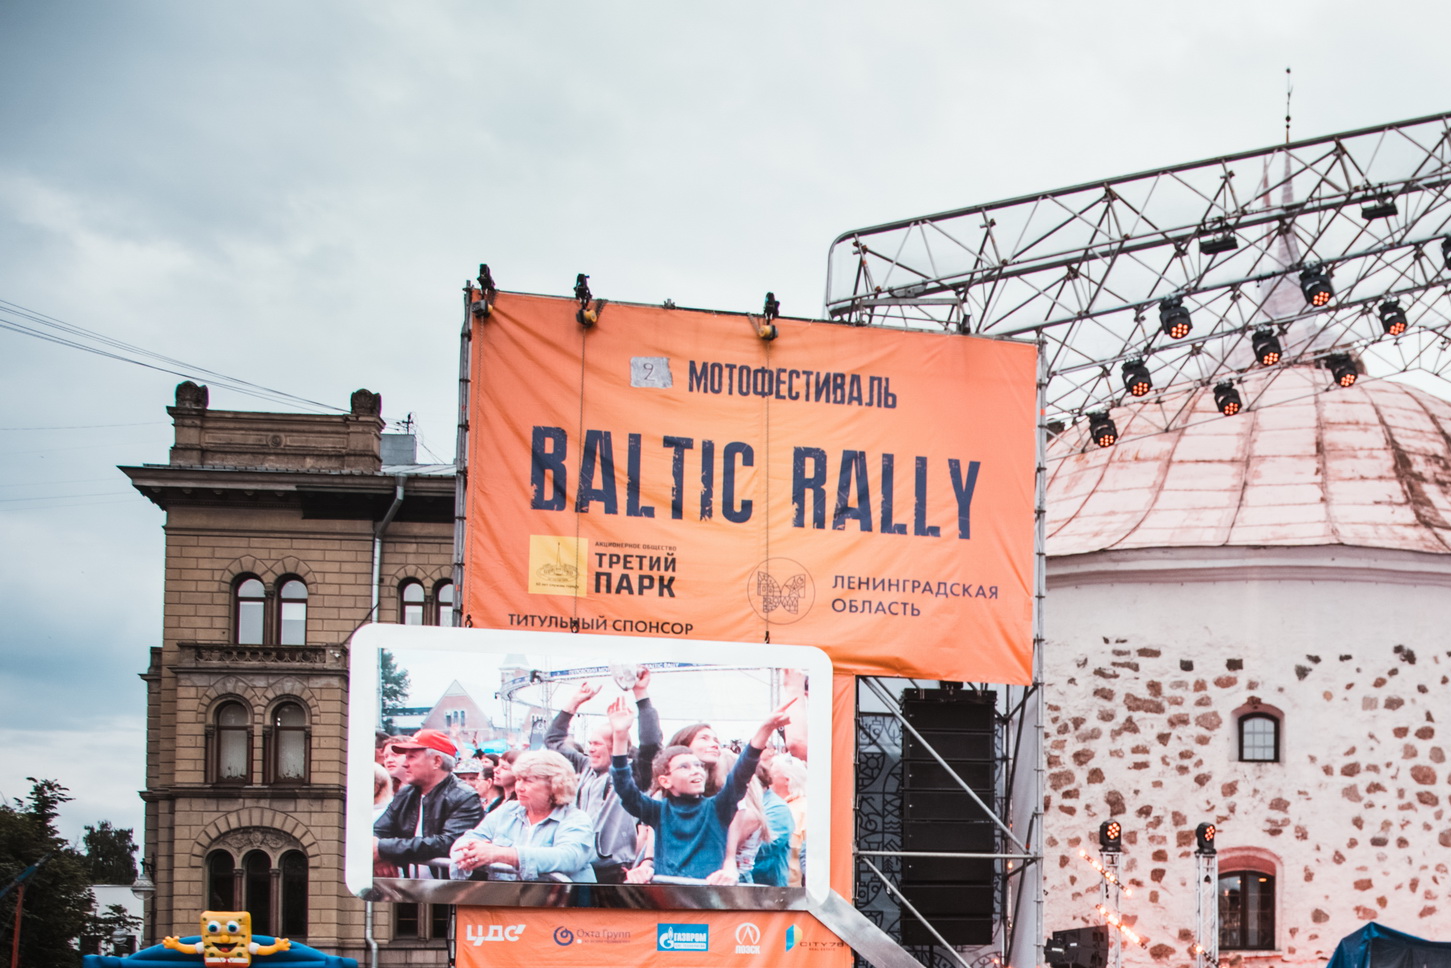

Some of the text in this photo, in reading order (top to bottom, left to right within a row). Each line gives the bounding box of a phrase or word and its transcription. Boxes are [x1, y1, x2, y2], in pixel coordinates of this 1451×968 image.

[688, 360, 898, 409] МОТОФЕСТИВАЛЬ
[530, 425, 981, 540] BALTIC RALLY
[595, 552, 677, 572] ТРЕТИЙ
[594, 571, 676, 598] ПАРК
[832, 574, 999, 600] ЛЕНИНГРАДСКАЯ
[831, 598, 921, 617] ОБЛАСТЬ
[508, 613, 694, 635] ТИТУЛЬНЫЙ СПОНСОР
[466, 924, 526, 946] ЦДС
